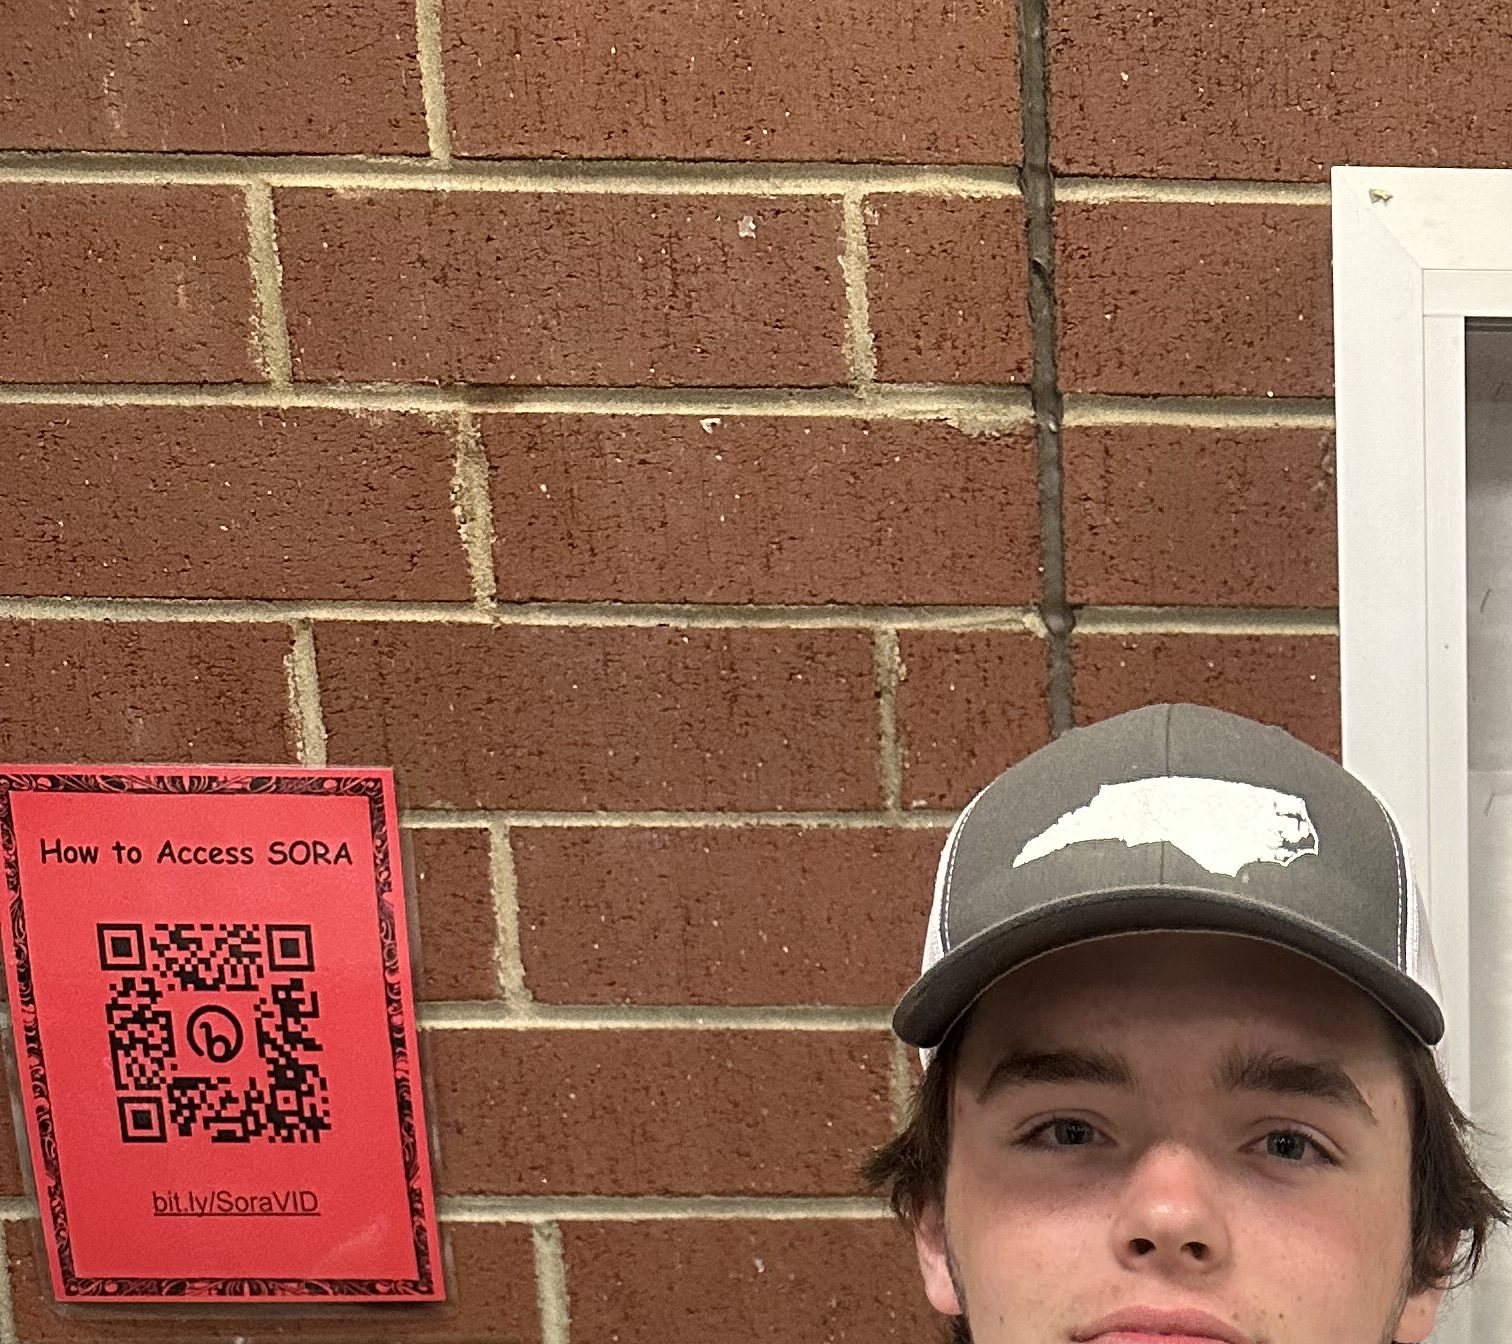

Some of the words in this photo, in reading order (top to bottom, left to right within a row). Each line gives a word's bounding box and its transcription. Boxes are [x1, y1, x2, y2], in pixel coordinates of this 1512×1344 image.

[40, 838, 98, 864] How
[112, 841, 142, 864] to
[156, 840, 254, 865] Access
[267, 840, 353, 866] SORA
[152, 1190, 320, 1214] bit.ly/SoraVID
